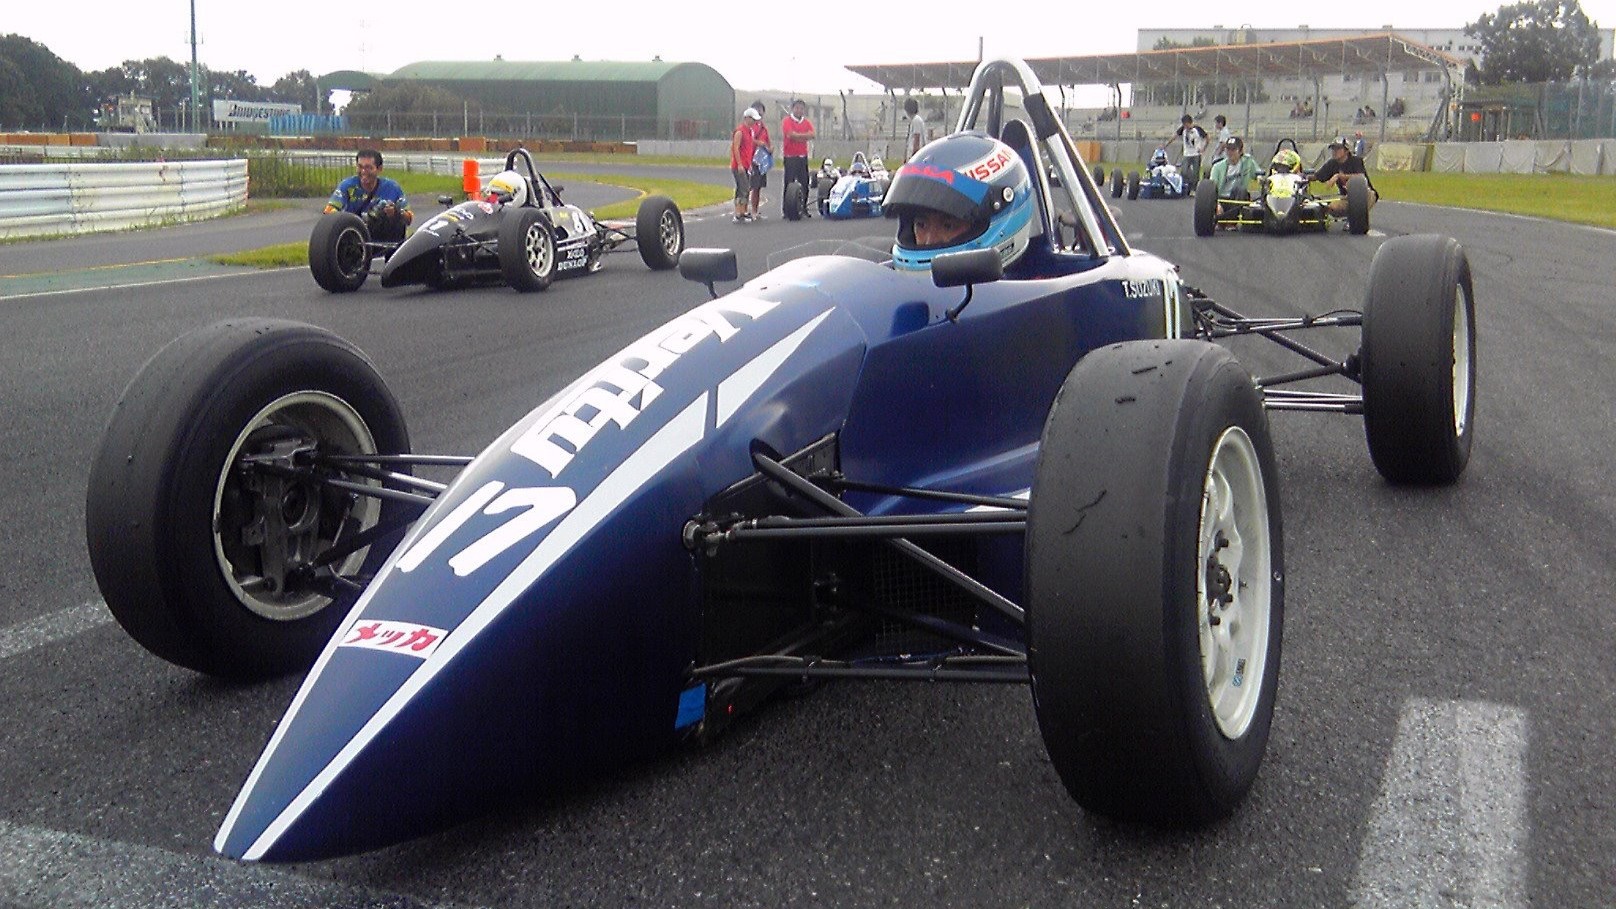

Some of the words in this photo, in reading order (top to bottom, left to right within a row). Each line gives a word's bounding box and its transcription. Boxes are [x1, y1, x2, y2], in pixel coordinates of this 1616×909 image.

[964, 148, 1012, 180] ISSA
[557, 255, 588, 271] DUNLOP
[395, 480, 577, 577] 17
[345, 623, 439, 652] メッカ
